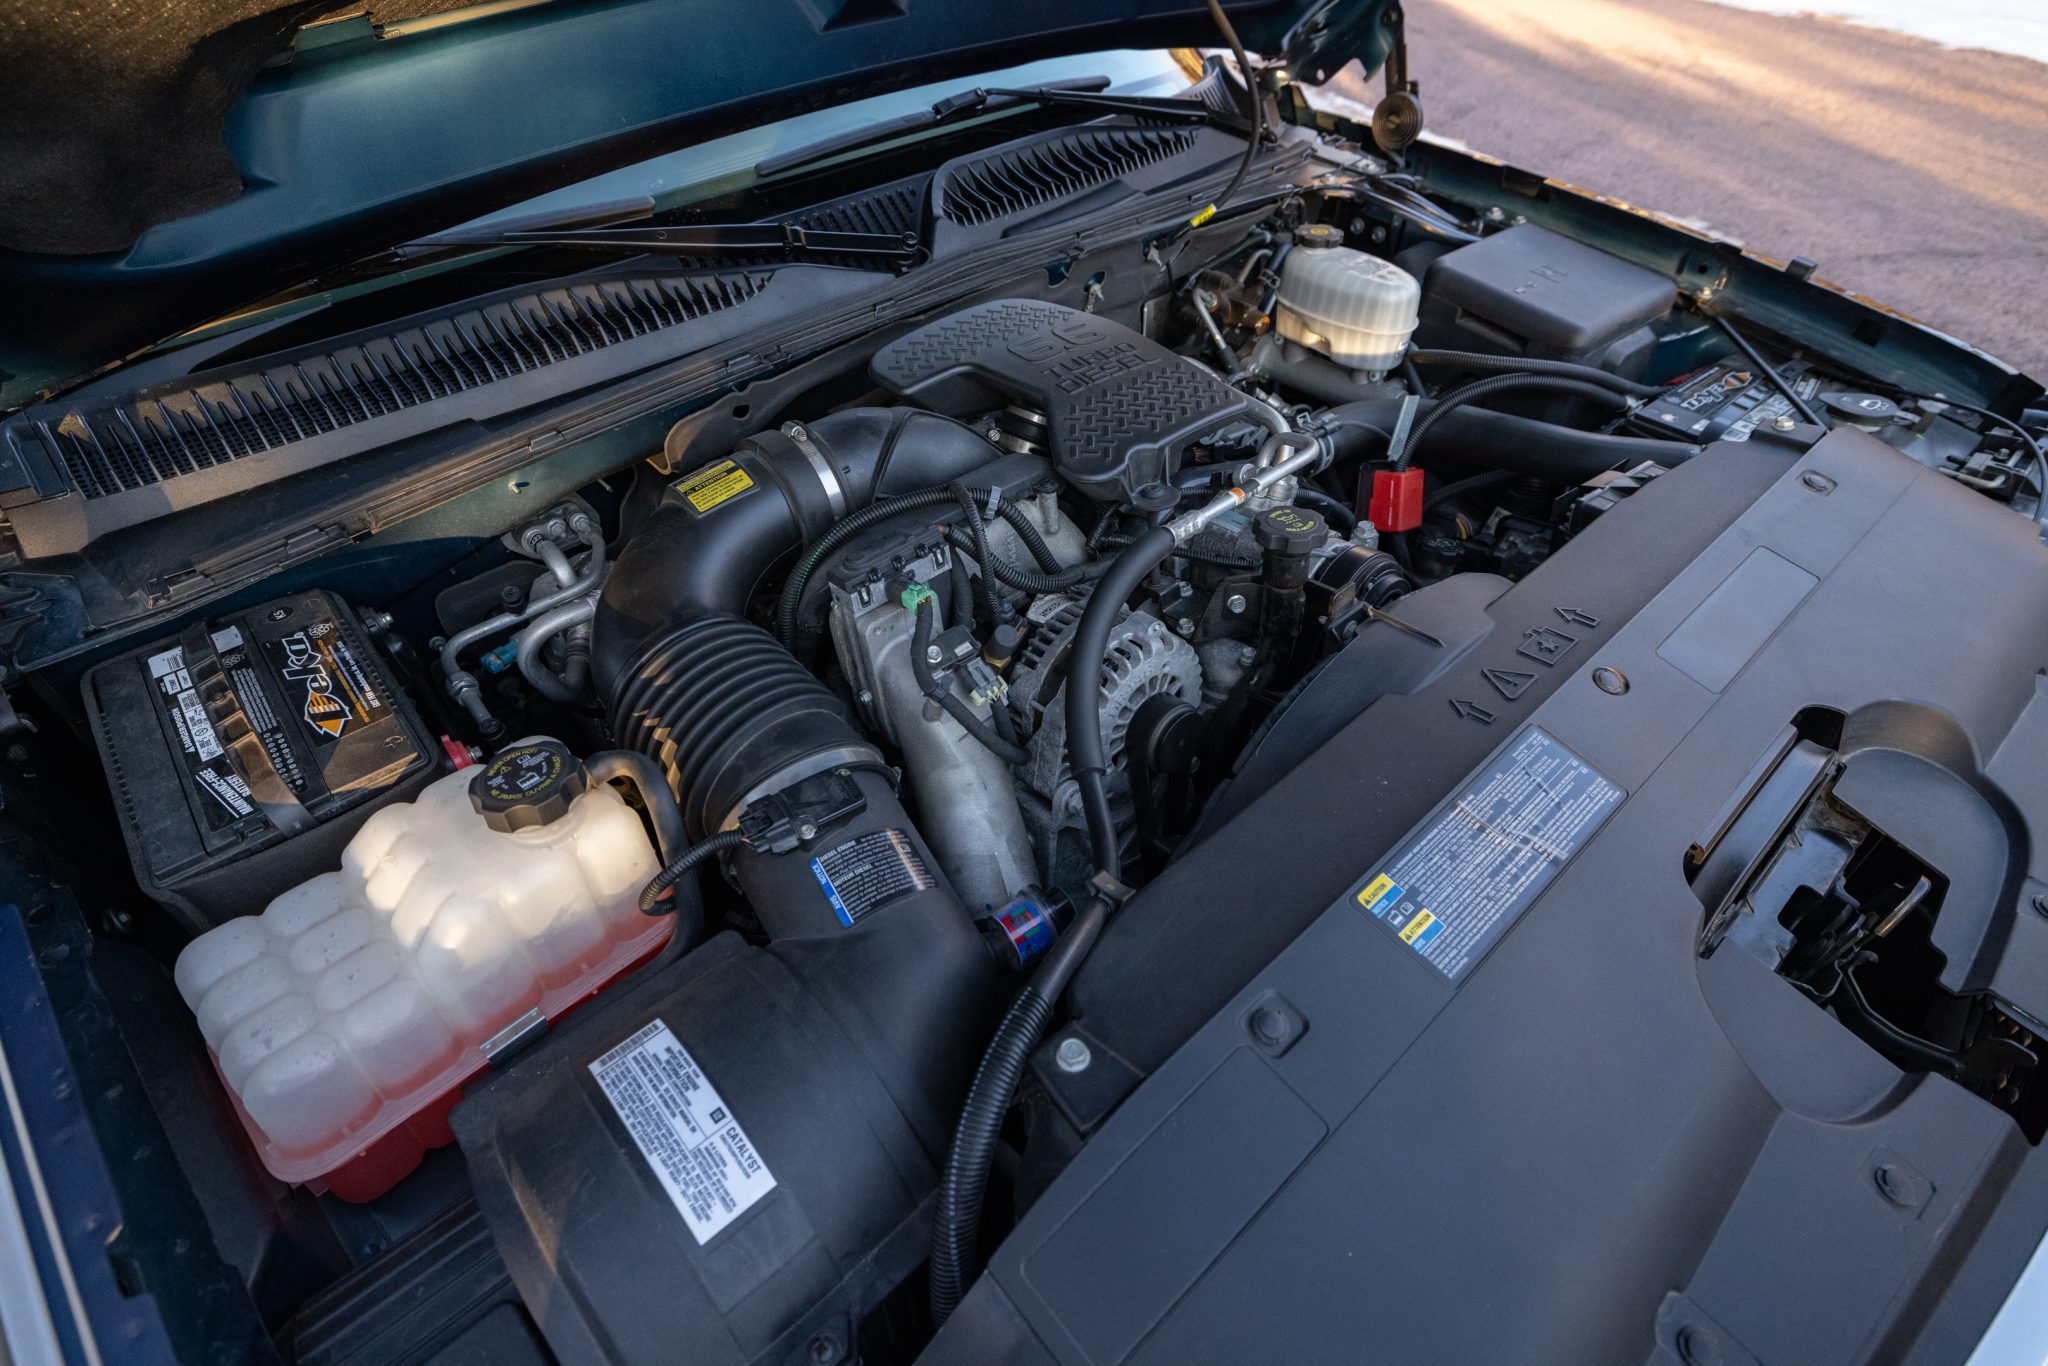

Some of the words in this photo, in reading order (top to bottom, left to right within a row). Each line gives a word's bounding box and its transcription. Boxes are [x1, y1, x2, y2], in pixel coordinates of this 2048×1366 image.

[1041, 342, 1138, 378] TURBO
[1055, 354, 1162, 396] DIESEL
[693, 471, 727, 491] ATTENTION
[204, 768, 254, 816] MAINTENANCE-FREE
[224, 774, 252, 798] BATTERY
[820, 849, 838, 862] DIESEL
[837, 840, 857, 852] ENGINE
[811, 862, 827, 885] NOTICE
[833, 870, 854, 887] MOTEUR
[854, 864, 873, 876] DIESEL
[829, 894, 841, 910] AVIS
[1366, 881, 1387, 900] CAUTION
[1407, 912, 1431, 936] ATTENTION
[663, 1057, 691, 1092] INFORMATION
[664, 1045, 686, 1072] IMPORTANT
[681, 1070, 699, 1091] ENGINE
[724, 1125, 763, 1175] CATALYST
